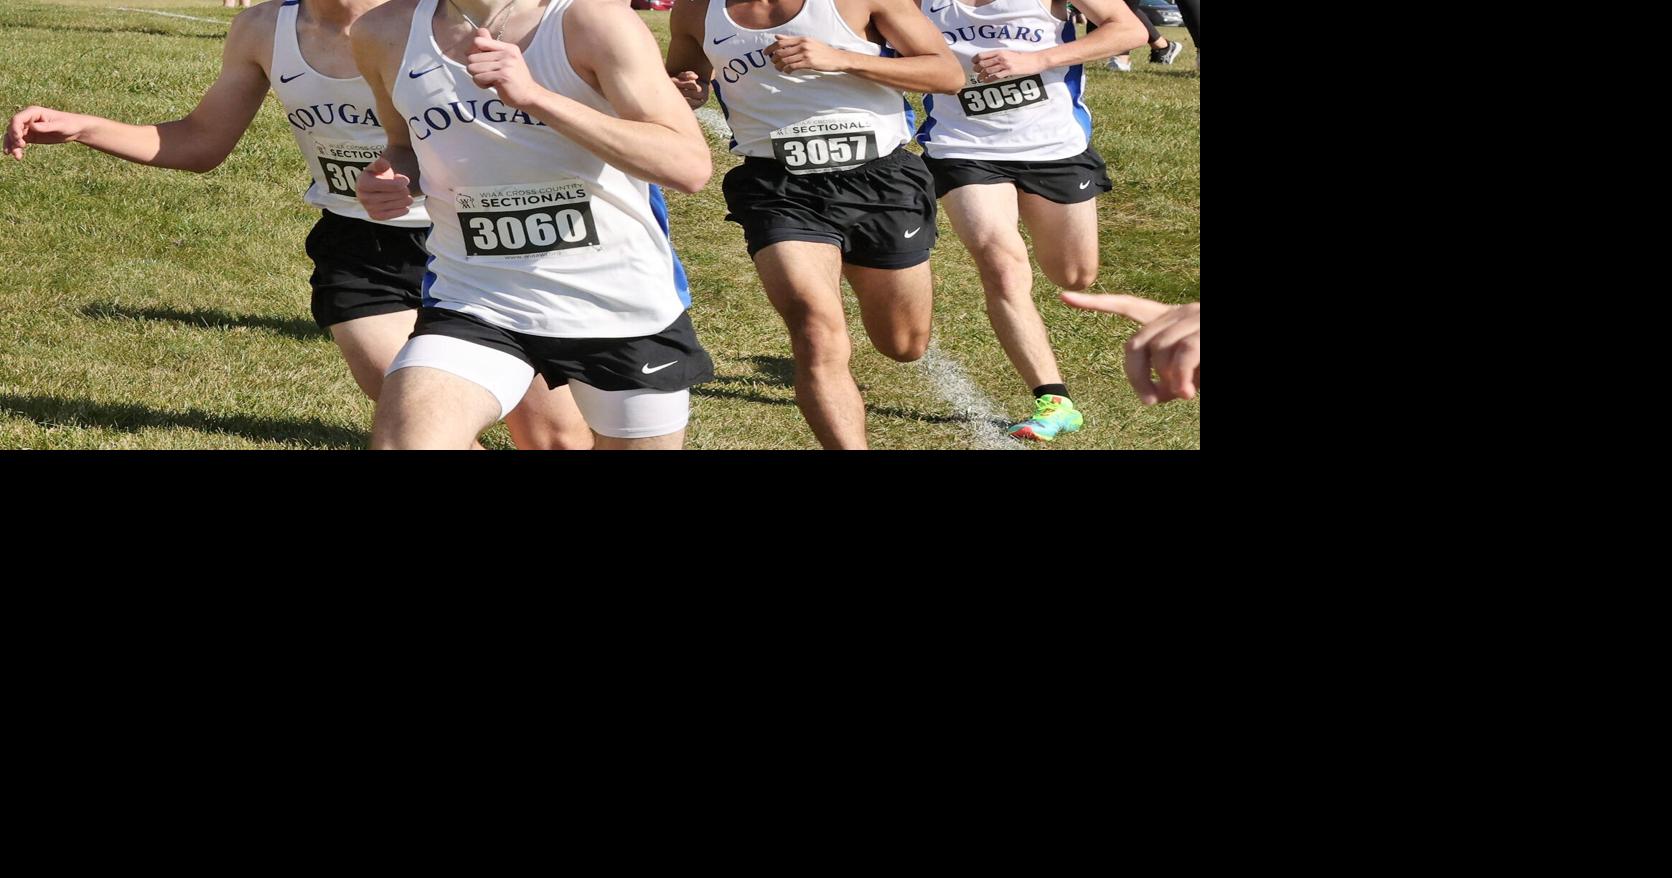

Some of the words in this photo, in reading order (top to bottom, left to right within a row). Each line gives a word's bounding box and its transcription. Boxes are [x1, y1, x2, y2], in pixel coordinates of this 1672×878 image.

[722, 48, 774, 84] COU
[963, 79, 1041, 112] 3059
[408, 99, 547, 141] COUGA
[793, 121, 872, 134] SECTIONAL
[783, 135, 867, 167] 3057
[326, 162, 367, 192] 30
[480, 190, 504, 199] WIAA
[506, 187, 537, 198] CROSS
[539, 183, 584, 195] COUNTRY
[481, 188, 586, 208] SECTIONALS
[469, 208, 588, 250] 3060
